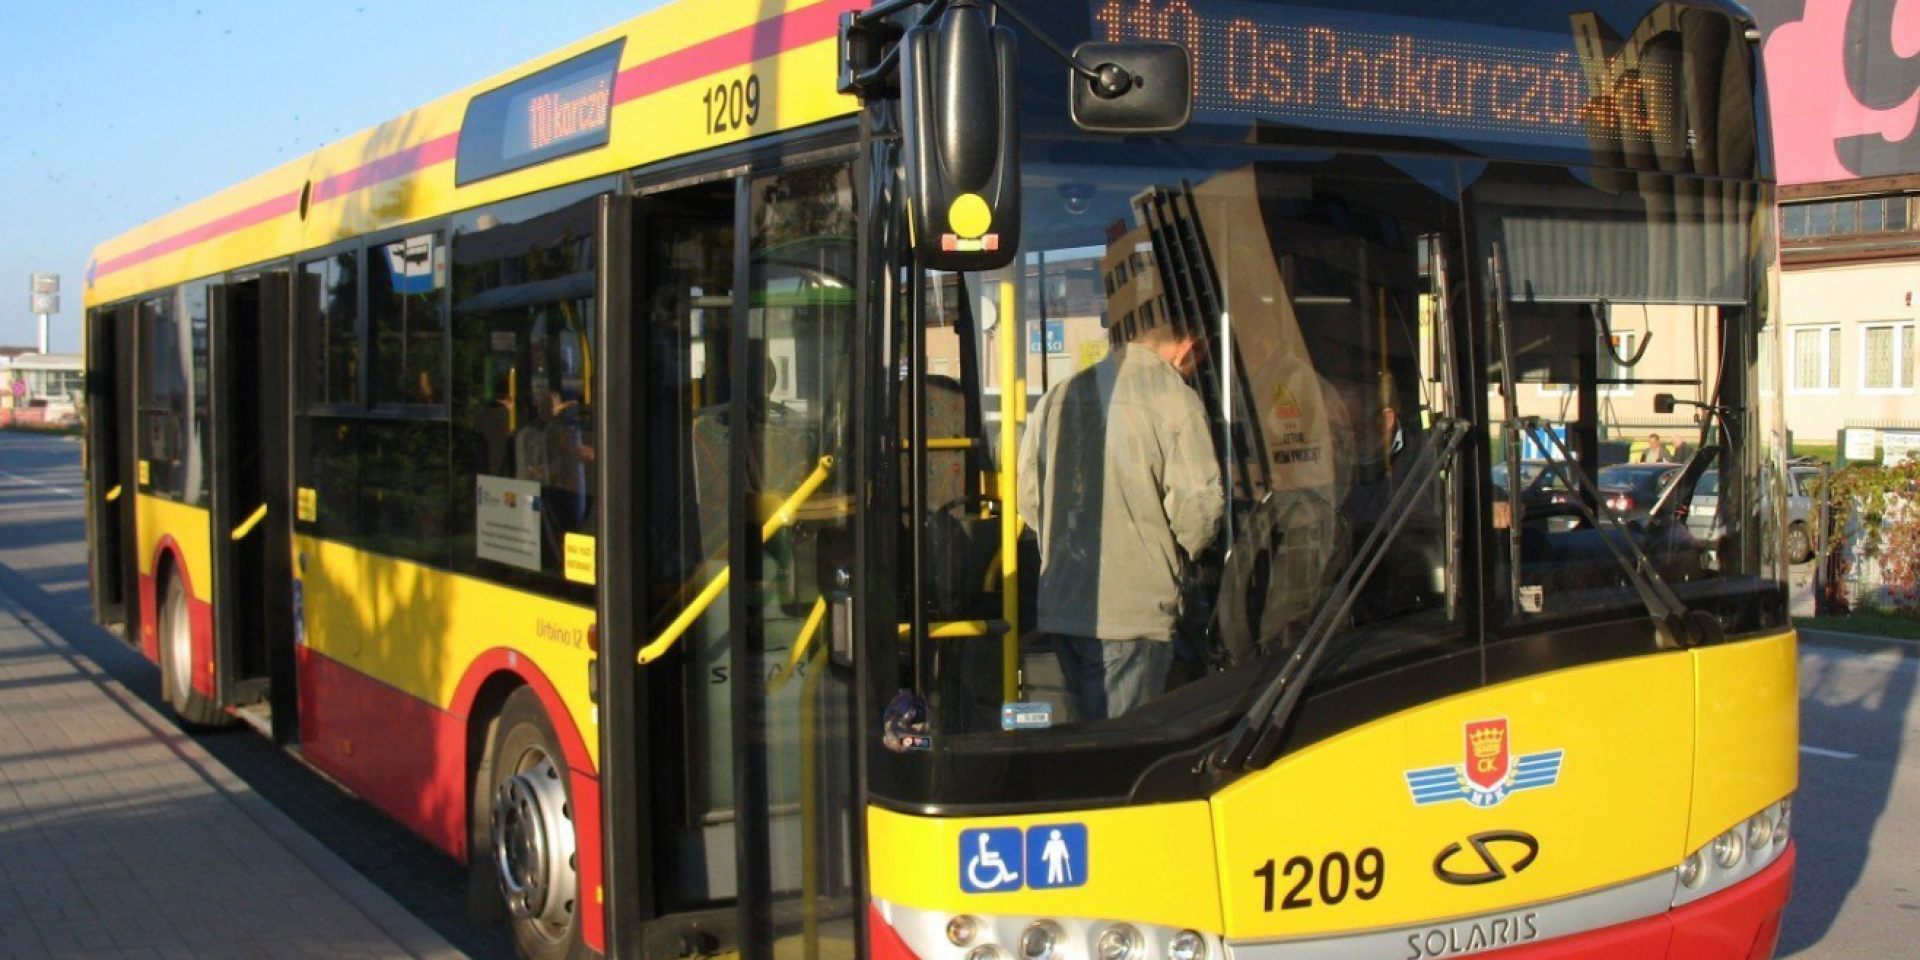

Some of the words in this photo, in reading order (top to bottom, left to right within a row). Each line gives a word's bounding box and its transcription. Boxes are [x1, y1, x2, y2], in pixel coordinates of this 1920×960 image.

[703, 74, 760, 135] 1209
[536, 617, 571, 646] Urbino
[572, 628, 583, 650] 12
[1477, 757, 1498, 773] CK
[1471, 786, 1506, 806] MPK
[1253, 846, 1386, 913] 1209
[1406, 912, 1539, 960] SOLARIS
